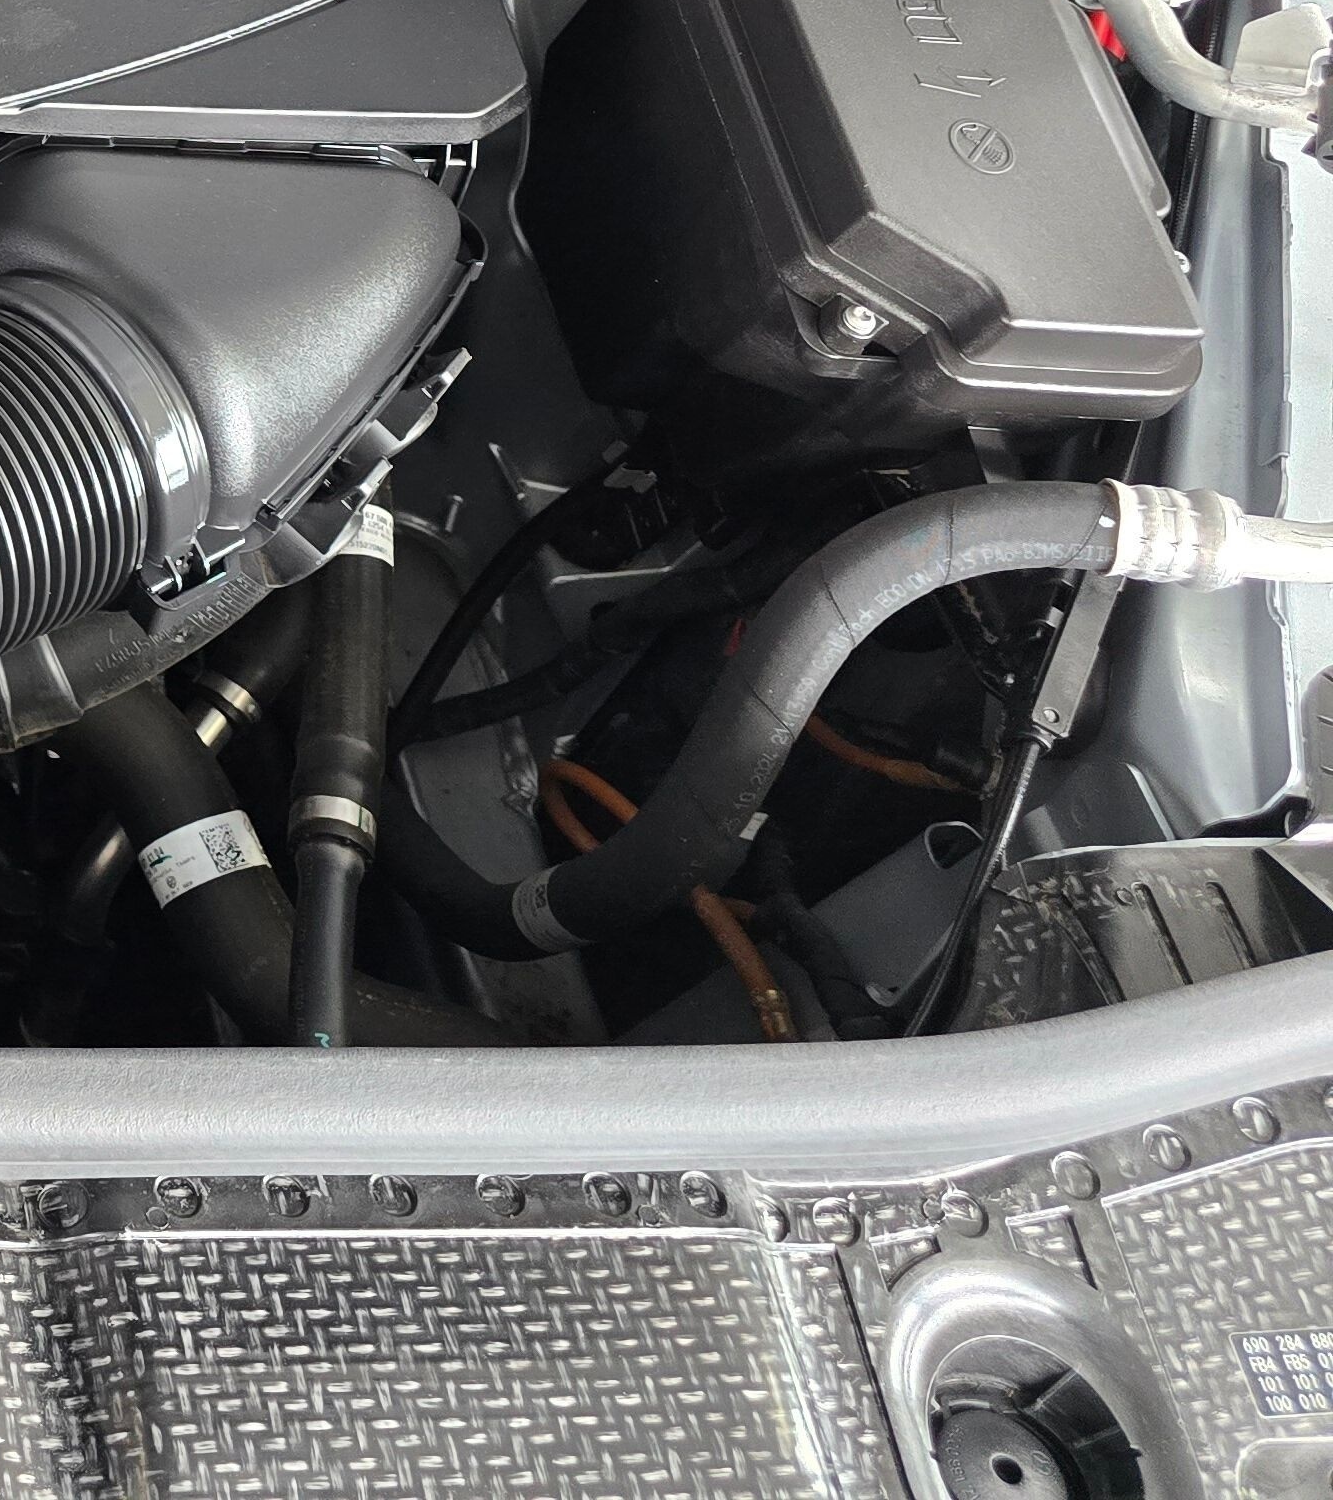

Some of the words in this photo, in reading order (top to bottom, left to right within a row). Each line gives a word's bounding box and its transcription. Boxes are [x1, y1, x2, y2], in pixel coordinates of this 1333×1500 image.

[1242, 1336, 1271, 1354] 690
[1275, 1334, 1305, 1352] 284
[1257, 1375, 1285, 1393] 101
[1292, 1372, 1319, 1390] 101
[1265, 1394, 1293, 1412] 100
[1298, 1392, 1326, 1410] 010
